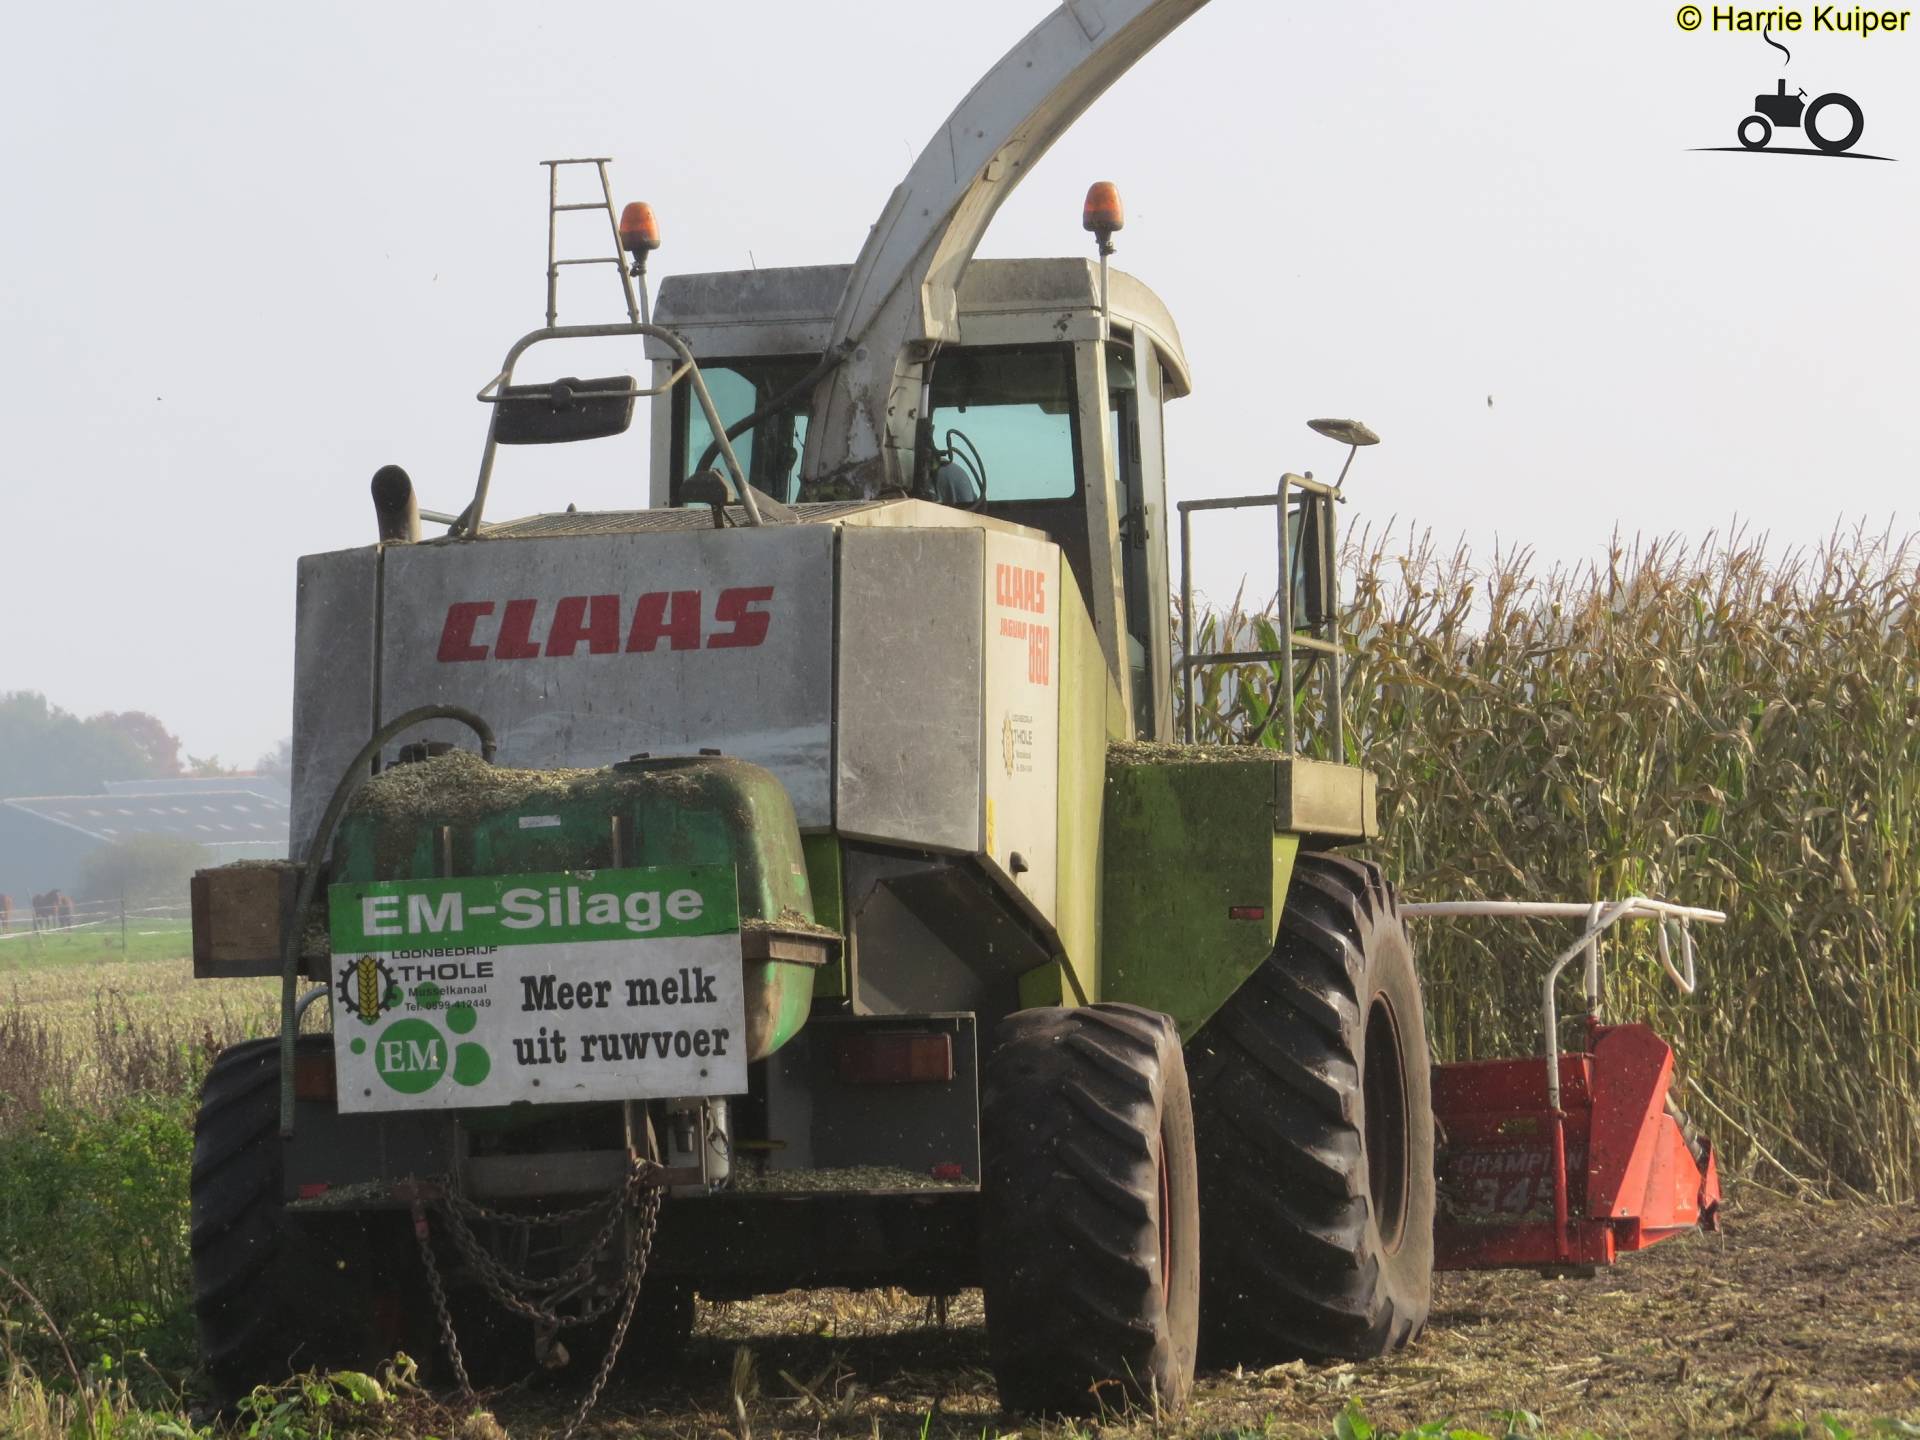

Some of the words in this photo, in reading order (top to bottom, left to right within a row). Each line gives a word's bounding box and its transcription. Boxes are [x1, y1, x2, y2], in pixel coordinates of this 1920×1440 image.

[996, 563, 1045, 614] CLAAS
[437, 586, 775, 663] CLAAS
[1000, 617, 1027, 641] JAGUAR
[1028, 623, 1050, 686] 860
[362, 886, 705, 936] EM-Silage
[391, 945, 498, 960] LOONBEDRIJF
[398, 962, 494, 982] THOLE
[408, 984, 488, 998] Musselkanaal
[520, 974, 612, 1012] Meer
[625, 967, 718, 1007] melk
[381, 1038, 441, 1074] EM
[513, 1026, 567, 1066] uit
[580, 1027, 730, 1062] ruwvoer
[1457, 1152, 1583, 1174] CHAMPIN
